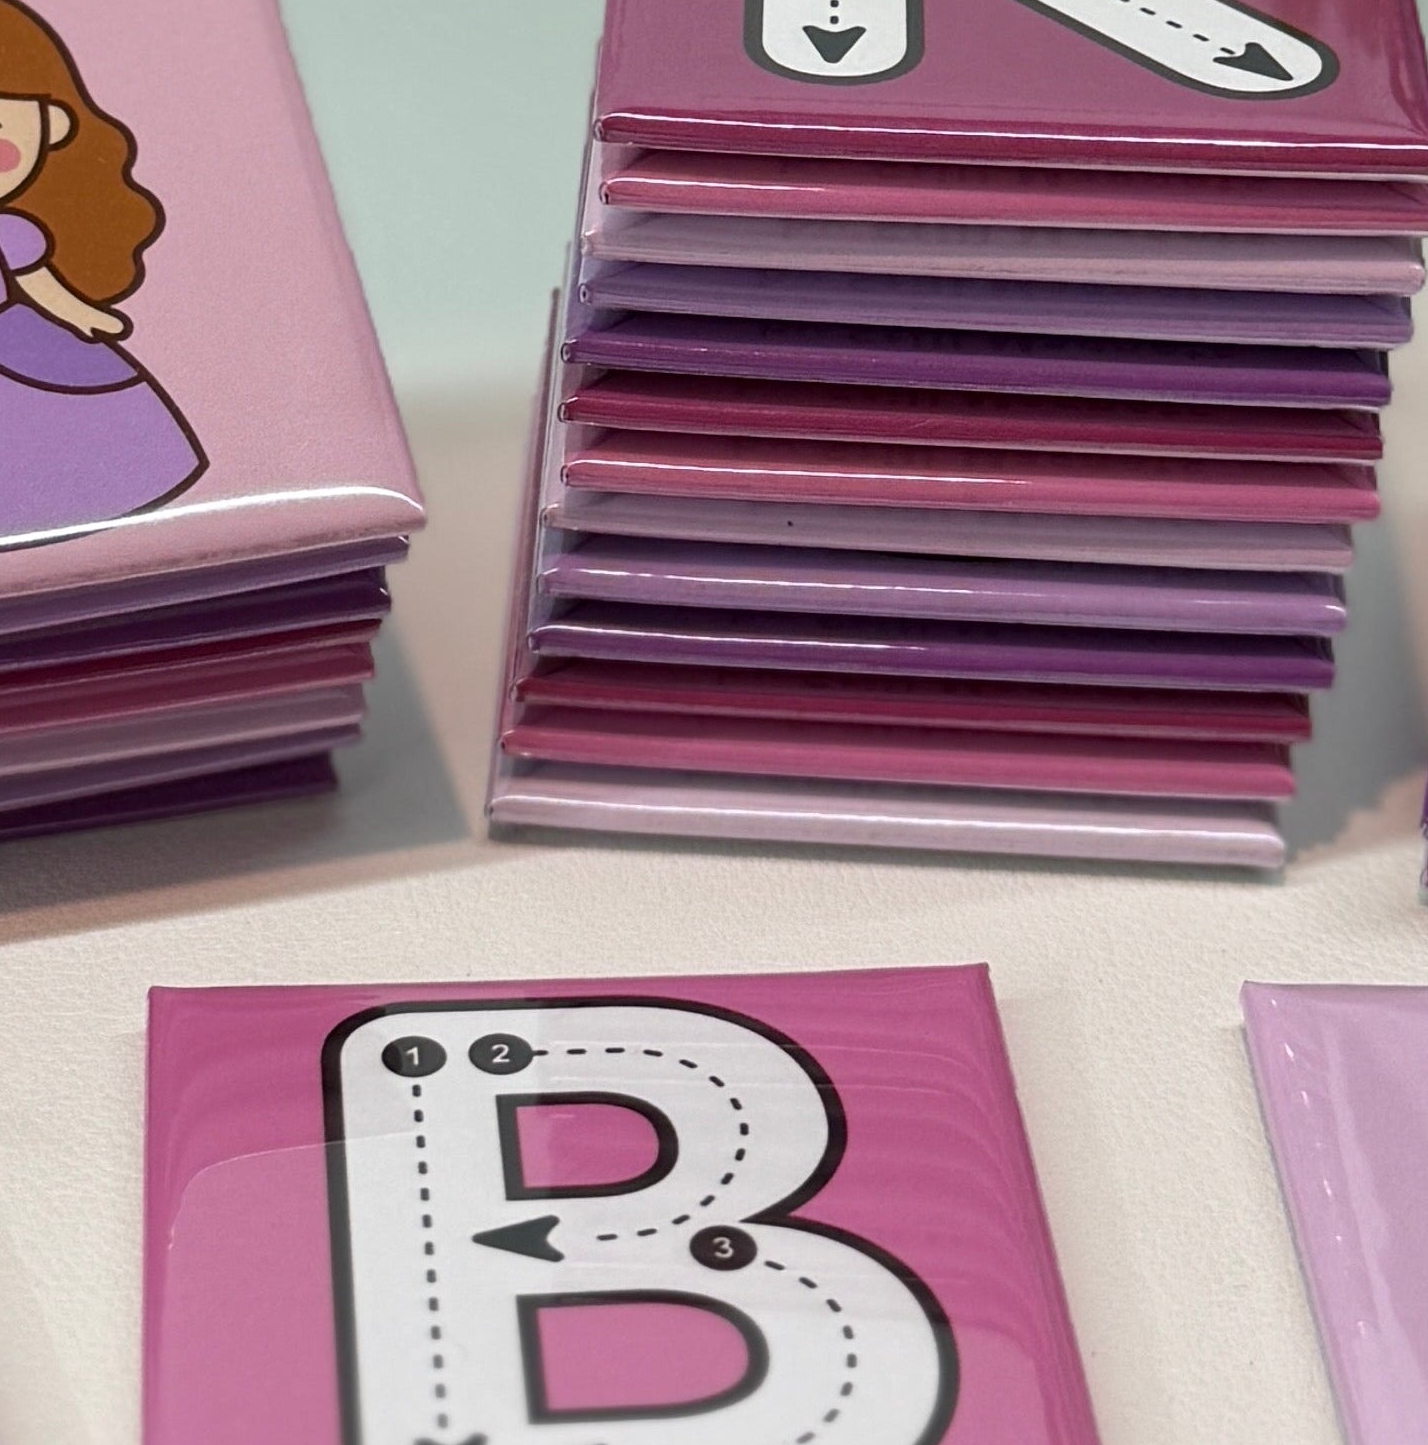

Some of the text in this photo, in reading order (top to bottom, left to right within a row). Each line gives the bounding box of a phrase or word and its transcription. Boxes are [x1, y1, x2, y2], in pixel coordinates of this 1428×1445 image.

[405, 1043, 511, 1066] 1 2
[712, 1236, 735, 1259] 3
